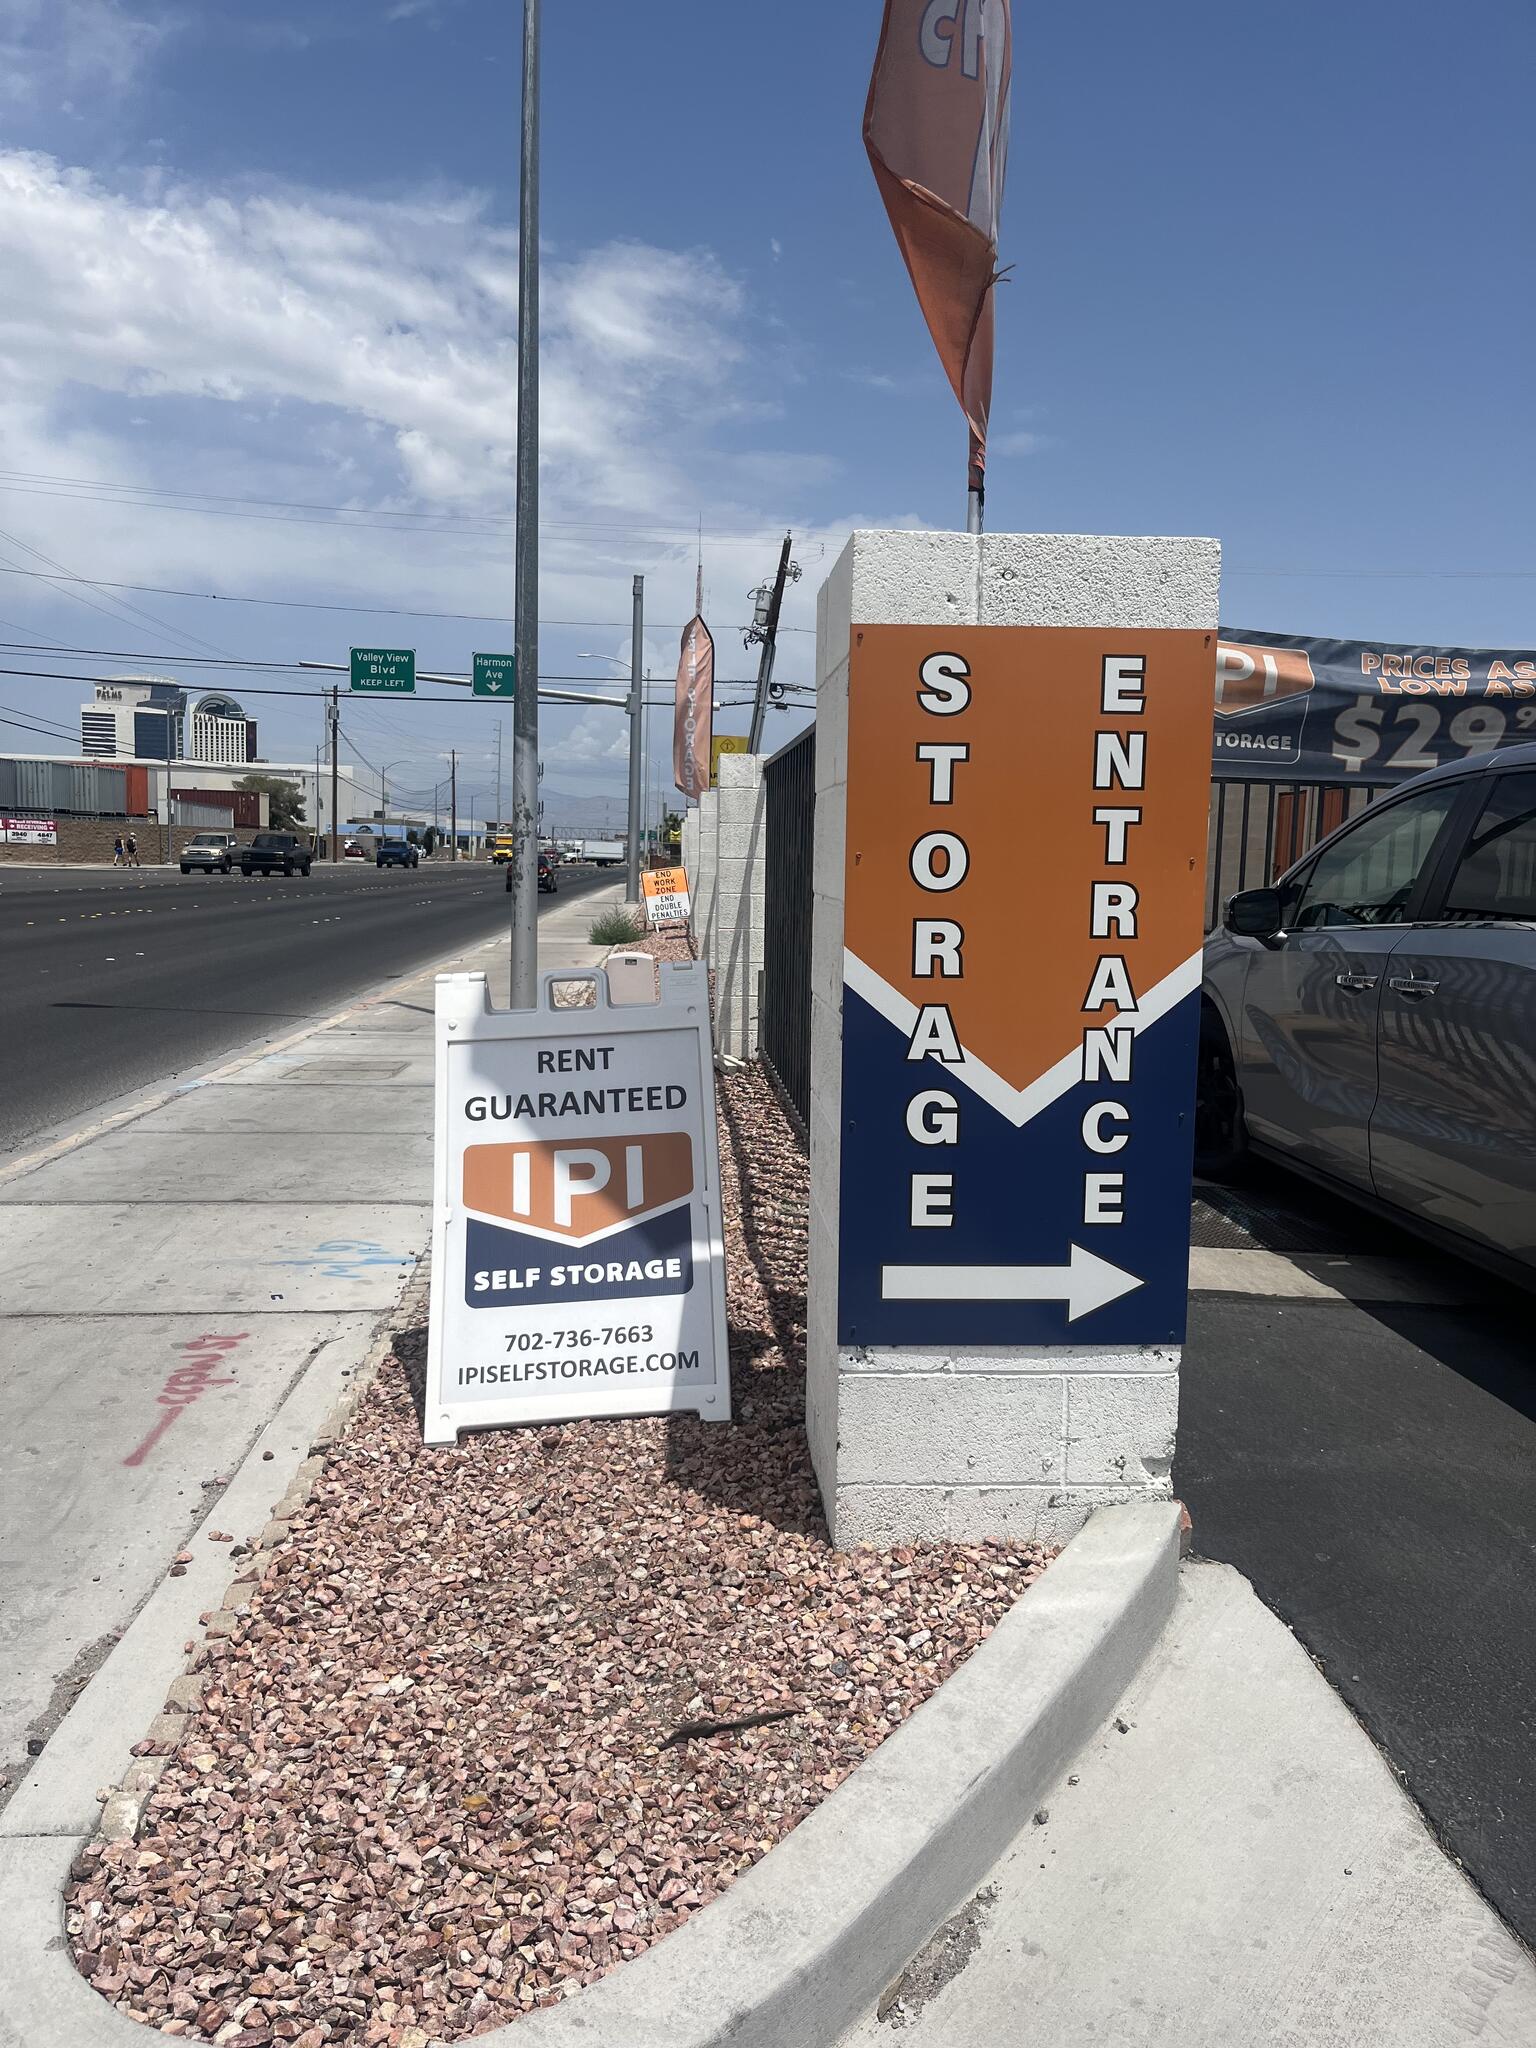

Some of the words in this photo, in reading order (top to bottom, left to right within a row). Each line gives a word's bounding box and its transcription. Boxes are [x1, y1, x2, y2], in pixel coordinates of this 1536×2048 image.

[356, 652, 384, 663] Valley
[386, 653, 409, 663] View
[476, 657, 512, 668] Harmon
[370, 664, 396, 675] Blvd
[1360, 652, 1471, 680] PRICES
[1486, 660, 1536, 680] AS
[485, 670, 504, 679] Ave
[1215, 647, 1279, 705] PI
[360, 678, 382, 686] KEEP
[384, 680, 405, 688] LEFT
[1376, 676, 1468, 697] LOW
[1483, 680, 1536, 699] AS
[96, 688, 123, 701] PALMS
[193, 714, 219, 724] PALMS
[1214, 732, 1292, 750] TORAGE
[655, 870, 671, 879] END
[653, 878, 676, 887] WORK
[655, 885, 677, 895] ZONE
[660, 894, 674, 903] END
[654, 901, 683, 911] DOUBLE
[651, 908, 688, 919] PENALTIES
[906, 651, 972, 1228] STORAGE
[1080, 653, 1147, 1226] ENTRANCE
[537, 1046, 615, 1074] RENT
[464, 1084, 687, 1122] GUARANTEED
[512, 1144, 644, 1228] IPI
[473, 1267, 541, 1292] SELF
[549, 1258, 682, 1286] STORAGE
[504, 1324, 654, 1353] 702-736-7663
[458, 1350, 700, 1385] IPISELFSTORAGE.COM
